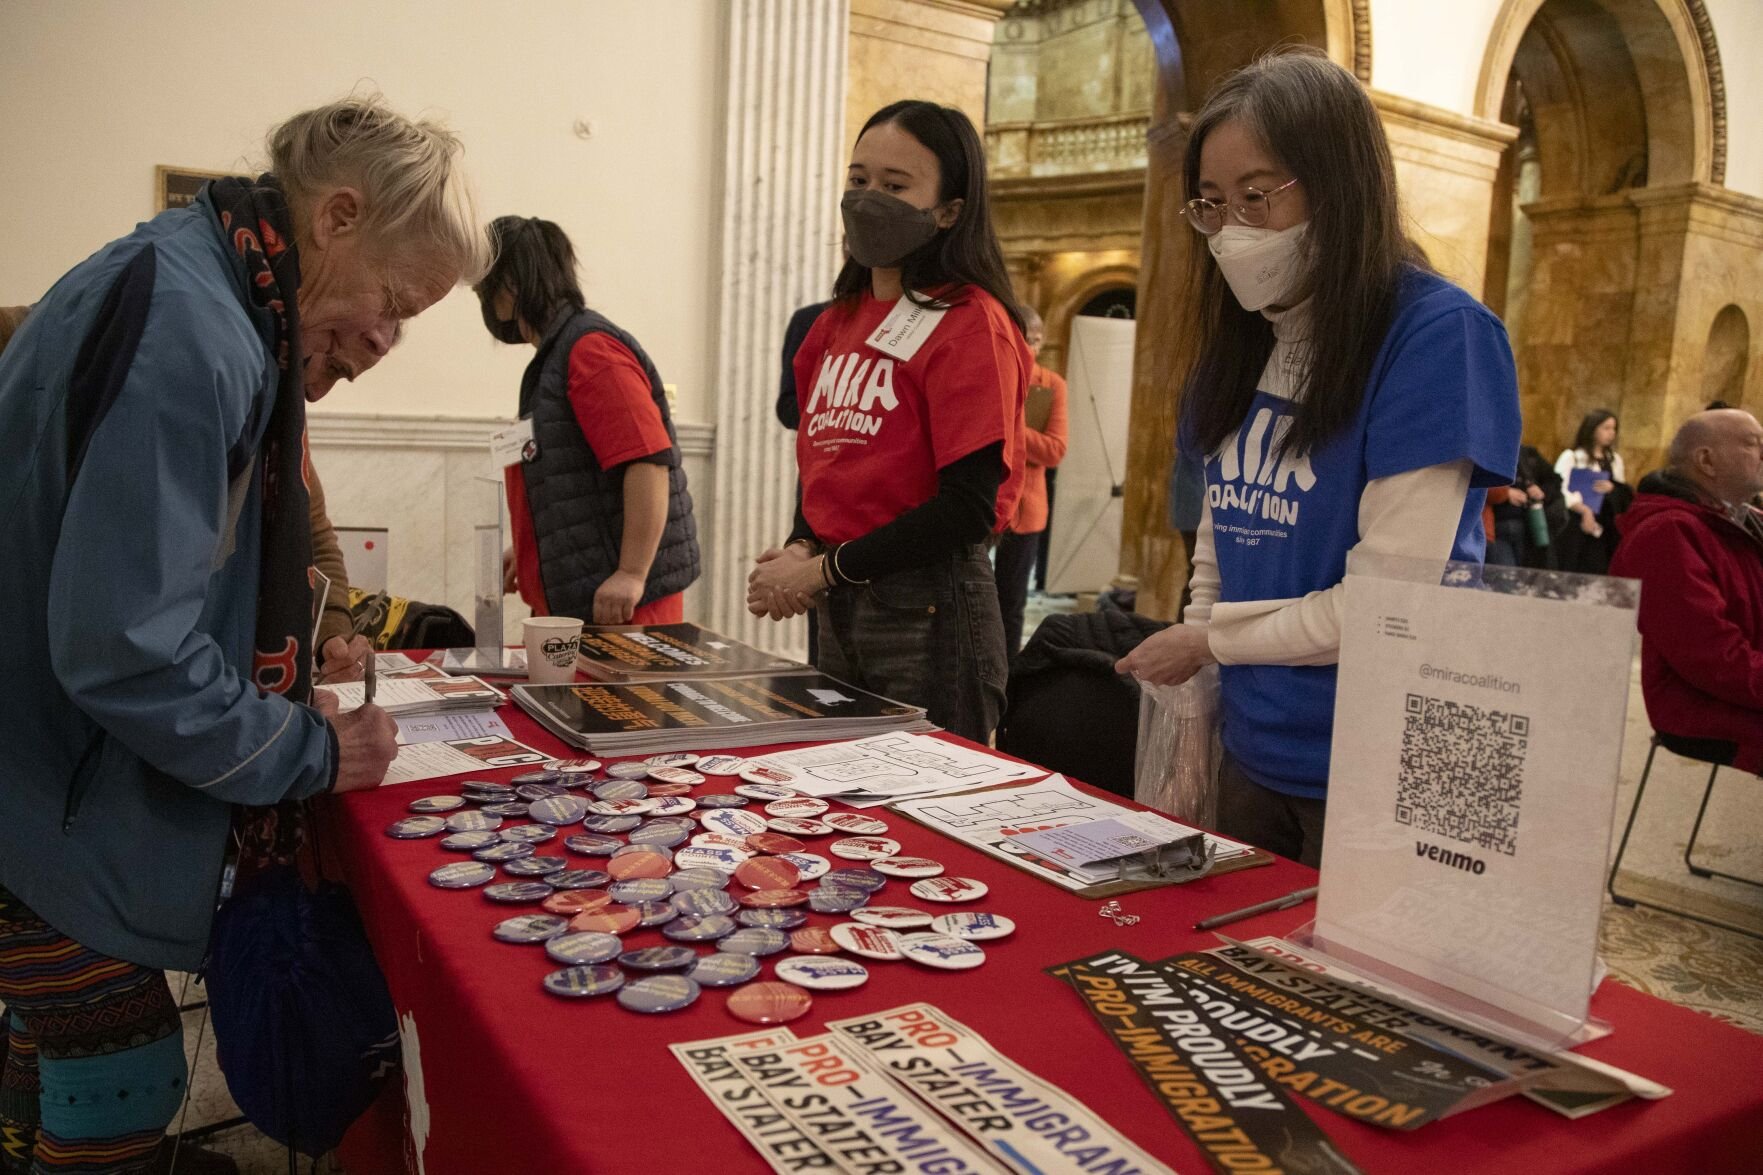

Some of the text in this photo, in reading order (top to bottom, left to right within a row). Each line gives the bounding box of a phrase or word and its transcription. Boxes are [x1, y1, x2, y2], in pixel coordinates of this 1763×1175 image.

[888, 322, 910, 347] Dawn
[807, 409, 883, 437] COALITION
[1207, 484, 1299, 526] OALIION
[547, 642, 578, 652] PLAZA
[1418, 662, 1522, 695] @miracoalition
[680, 847, 723, 857] MASS
[1415, 840, 1487, 876] venmo
[1178, 959, 1409, 1055] ALL IMMIGRANTS ARE
[1217, 946, 1412, 1031] BAY STATER
[1122, 977, 1286, 1111] I'M PROUDLY
[1186, 987, 1336, 1062] OUDLY
[685, 1046, 746, 1083] BAY
[843, 1020, 913, 1051] BAY
[890, 1056, 1014, 1134] STATER
[739, 1053, 812, 1089] BAY
[783, 1094, 906, 1175] STATER
